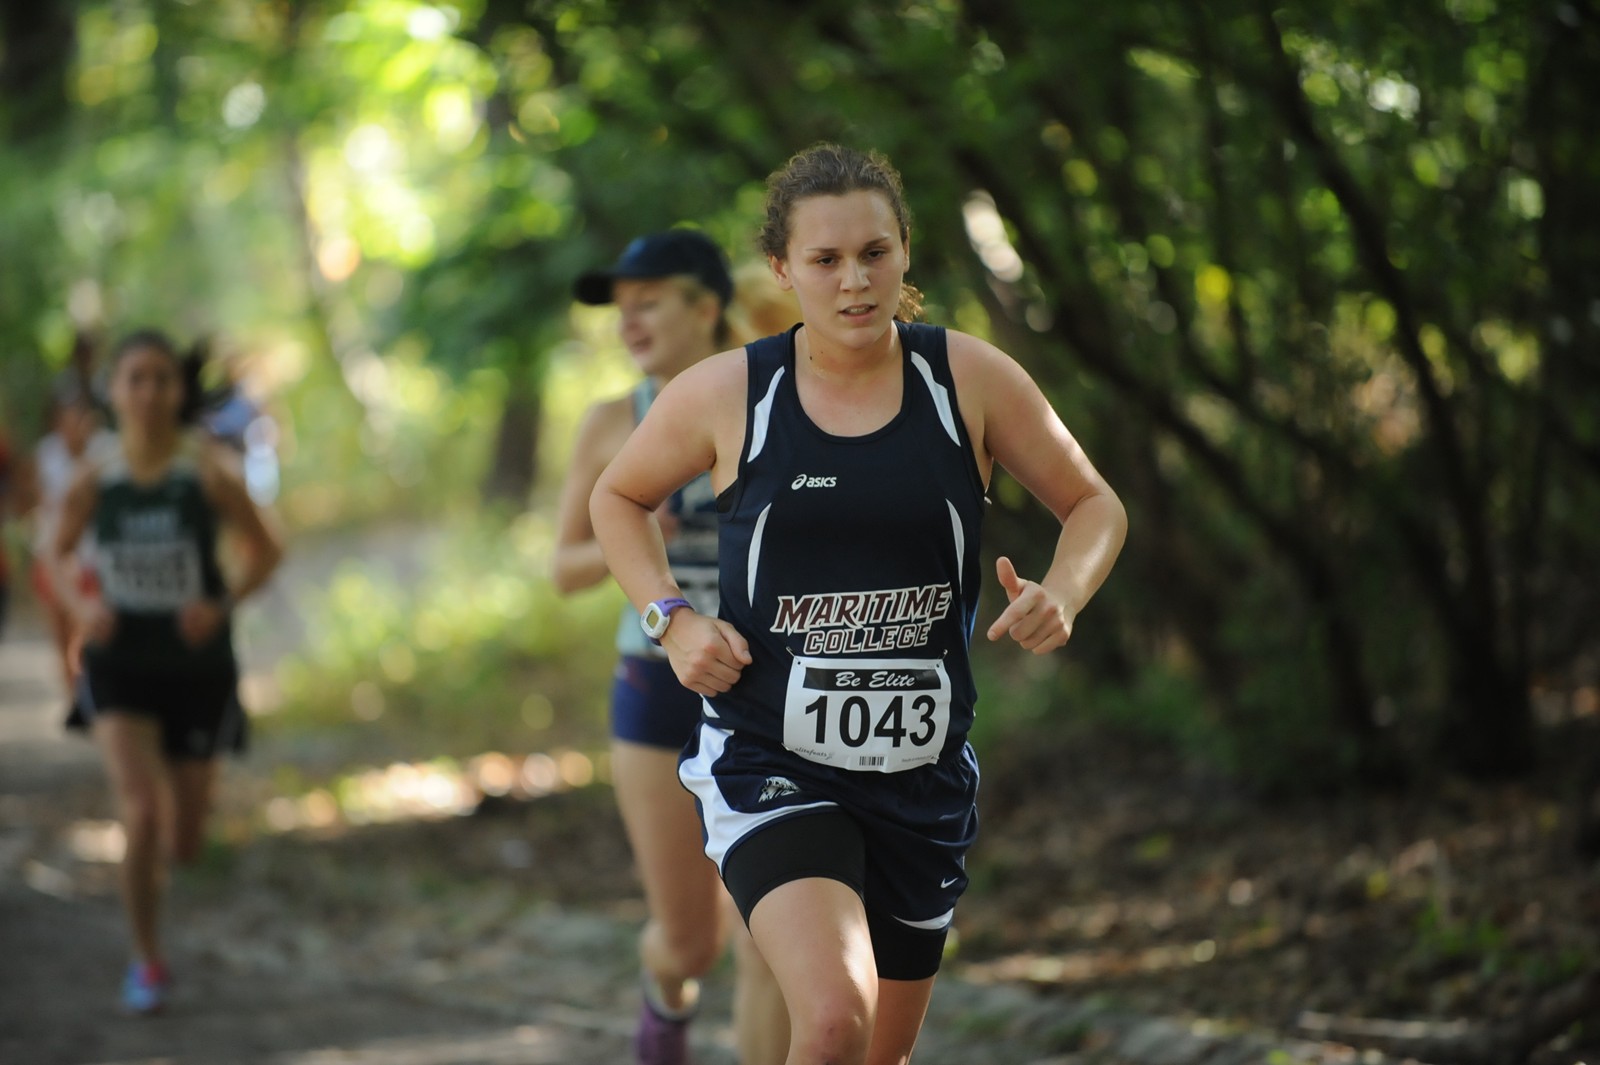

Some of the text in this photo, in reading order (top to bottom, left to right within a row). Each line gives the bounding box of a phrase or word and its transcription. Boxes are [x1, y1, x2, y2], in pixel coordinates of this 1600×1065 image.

[806, 476, 837, 488] asics
[769, 581, 952, 636] MARITIME
[803, 621, 932, 655] COLLEGE
[835, 671, 917, 688] Be Elite
[805, 694, 936, 748] 1043
